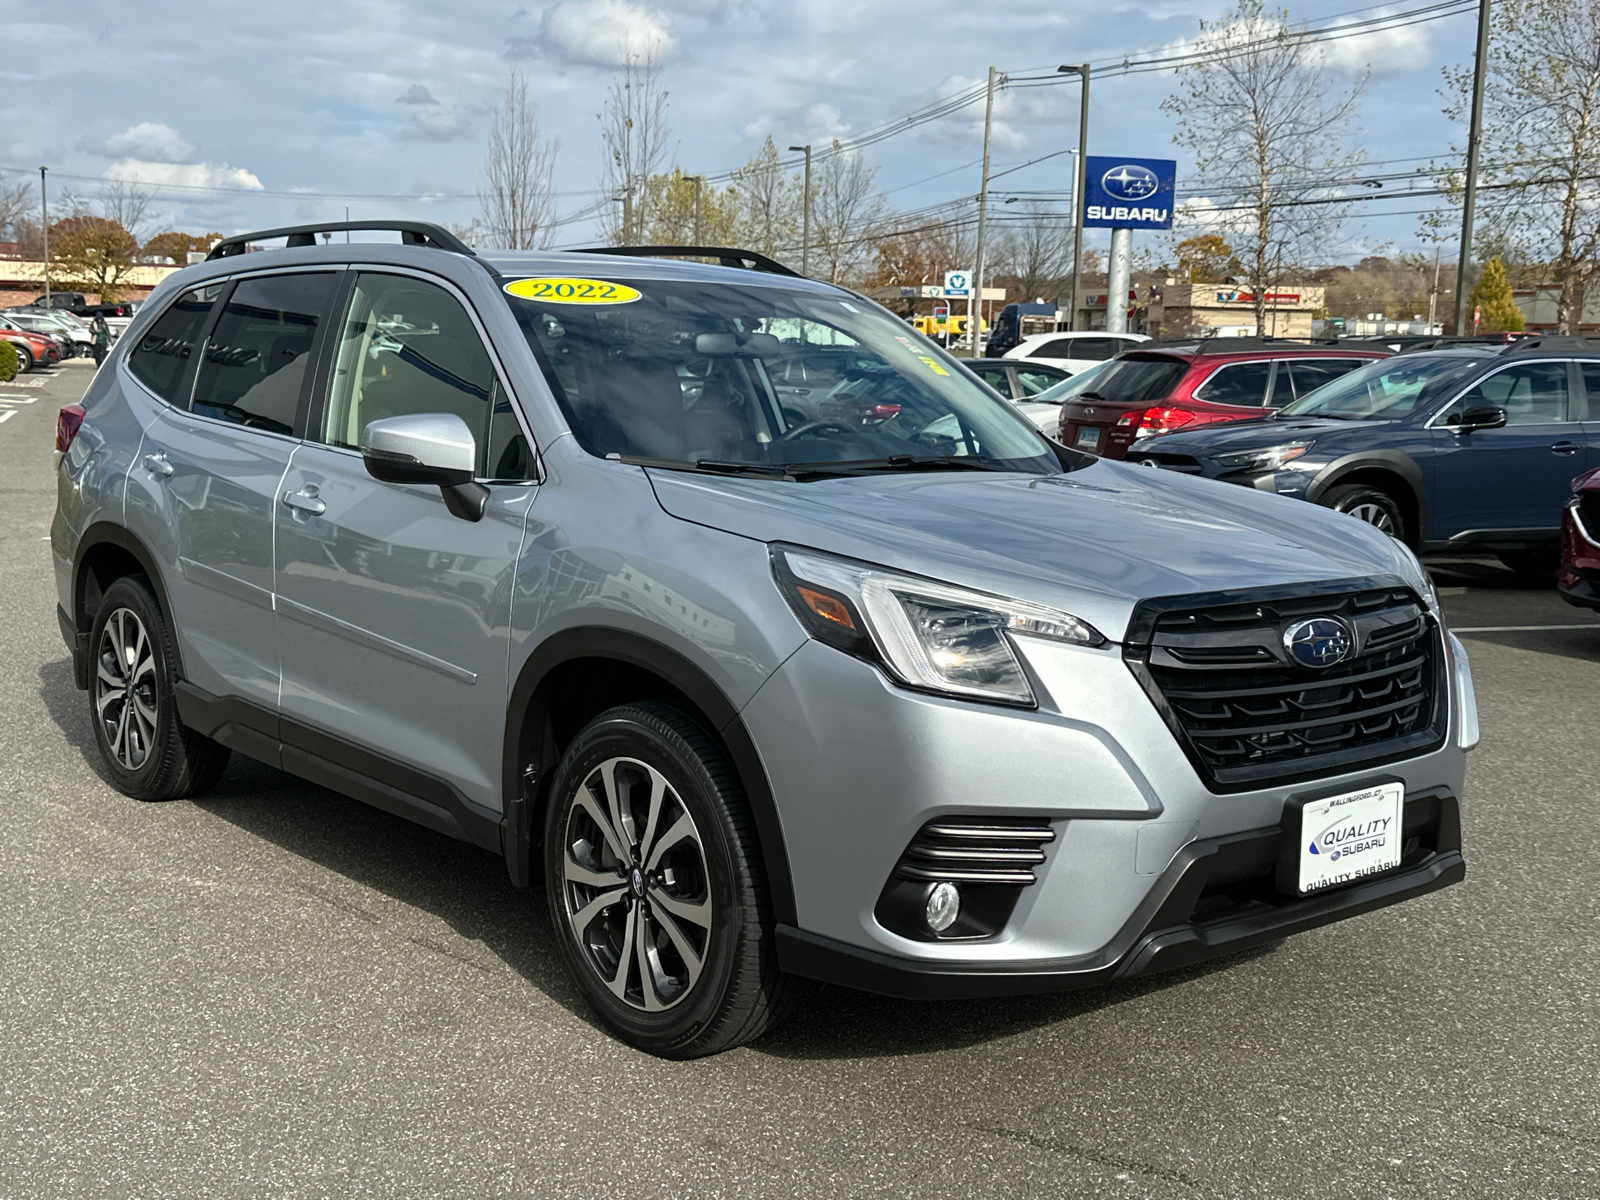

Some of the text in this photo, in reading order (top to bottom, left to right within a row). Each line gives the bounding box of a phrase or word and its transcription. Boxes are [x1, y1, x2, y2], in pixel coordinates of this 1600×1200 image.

[1086, 205, 1168, 222] SUBARU
[533, 283, 618, 299] 2022
[1323, 816, 1391, 845] QUALITY
[1341, 837, 1386, 856] SUBARU
[1306, 860, 1397, 890] QUALITY SUBARU
